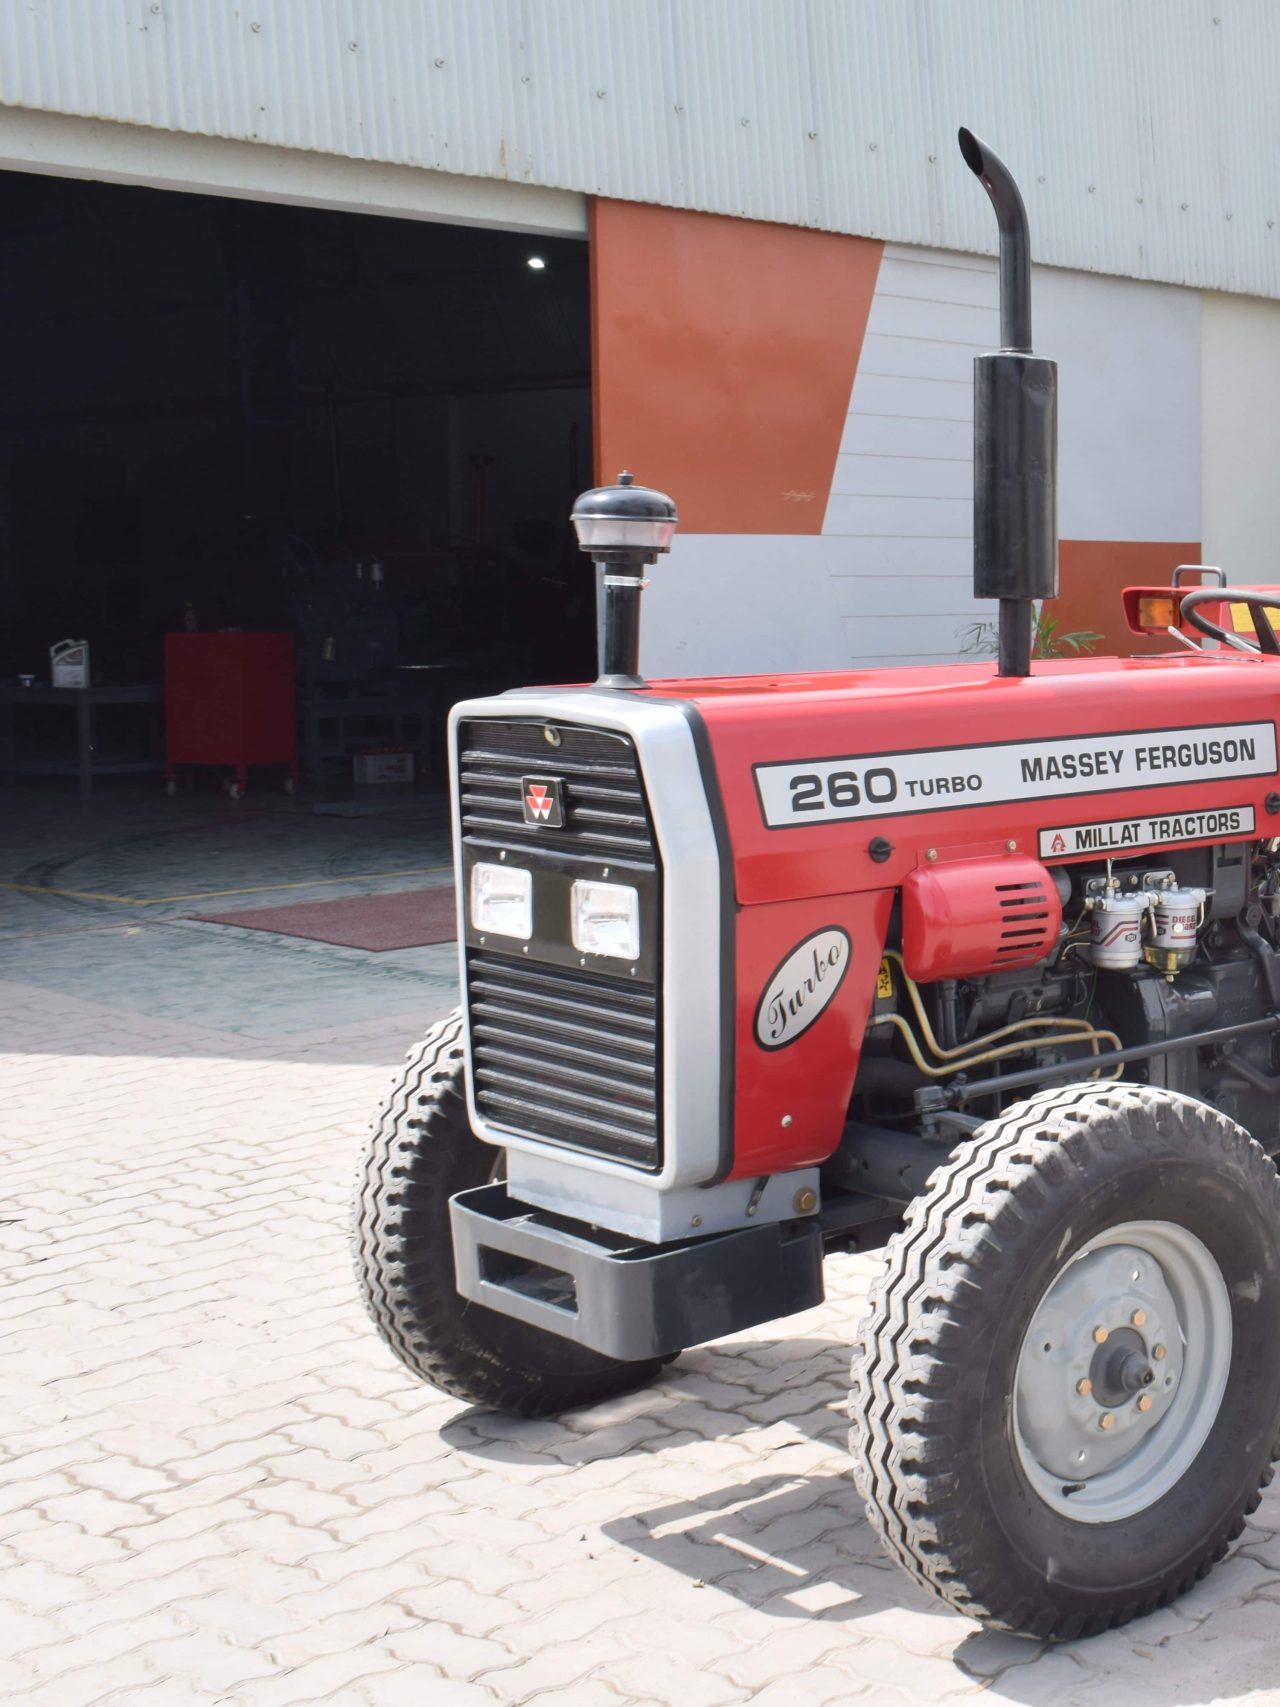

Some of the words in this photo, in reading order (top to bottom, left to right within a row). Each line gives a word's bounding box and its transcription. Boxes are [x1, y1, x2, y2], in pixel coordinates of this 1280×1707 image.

[789, 767, 898, 813] 260
[904, 774, 983, 797] TURBO
[1020, 749, 1124, 783] MASSEY
[1134, 737, 1256, 771] FERGUSON
[1075, 823, 1141, 850] MILLAT
[1148, 811, 1241, 840] TRACTORS
[767, 937, 844, 1039] Turbo
